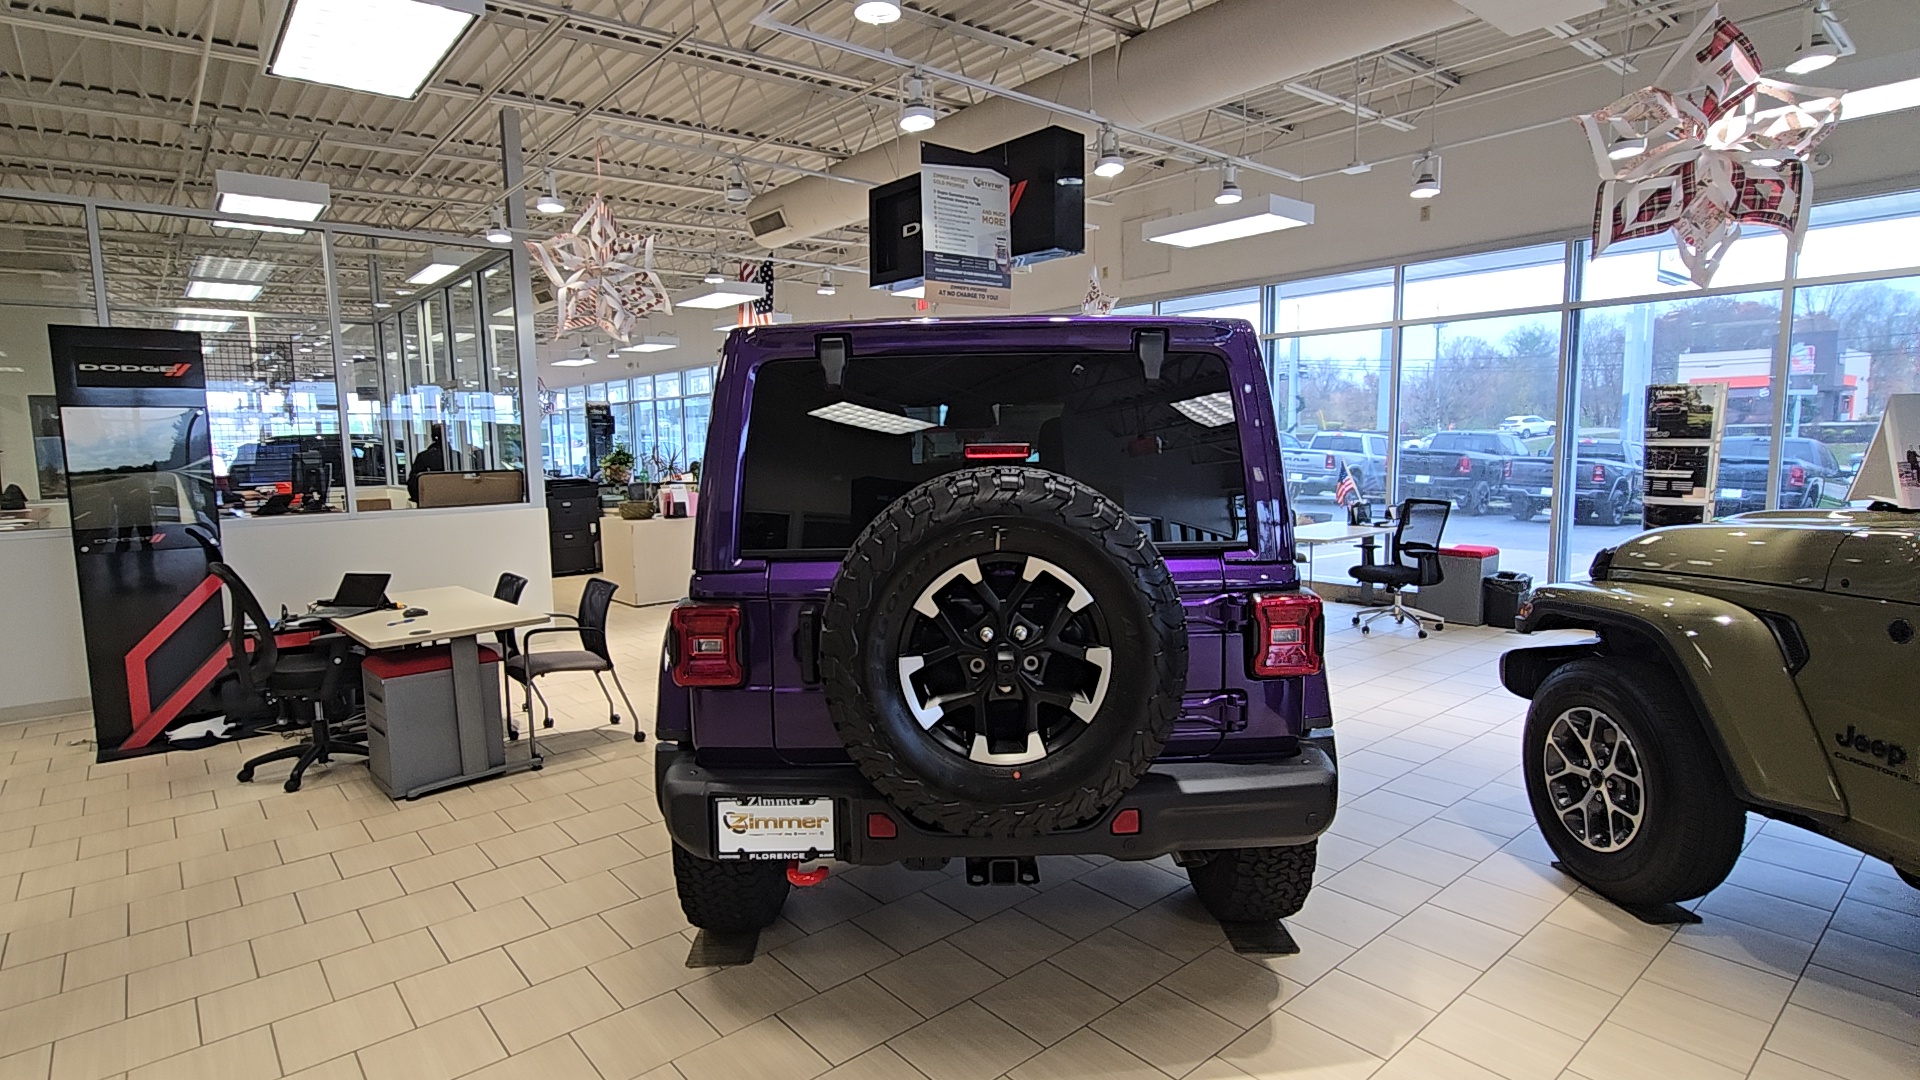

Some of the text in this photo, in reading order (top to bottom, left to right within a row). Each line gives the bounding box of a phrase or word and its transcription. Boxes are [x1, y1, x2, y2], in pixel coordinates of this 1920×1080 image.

[982, 215, 1006, 227] MORE!
[956, 291, 977, 299] CHARGE
[78, 363, 177, 373] DODGE
[1835, 725, 1907, 767] Jeep
[746, 796, 804, 807] Zimmer
[727, 811, 830, 830] Zimmer
[748, 852, 806, 860] FLORENCE
